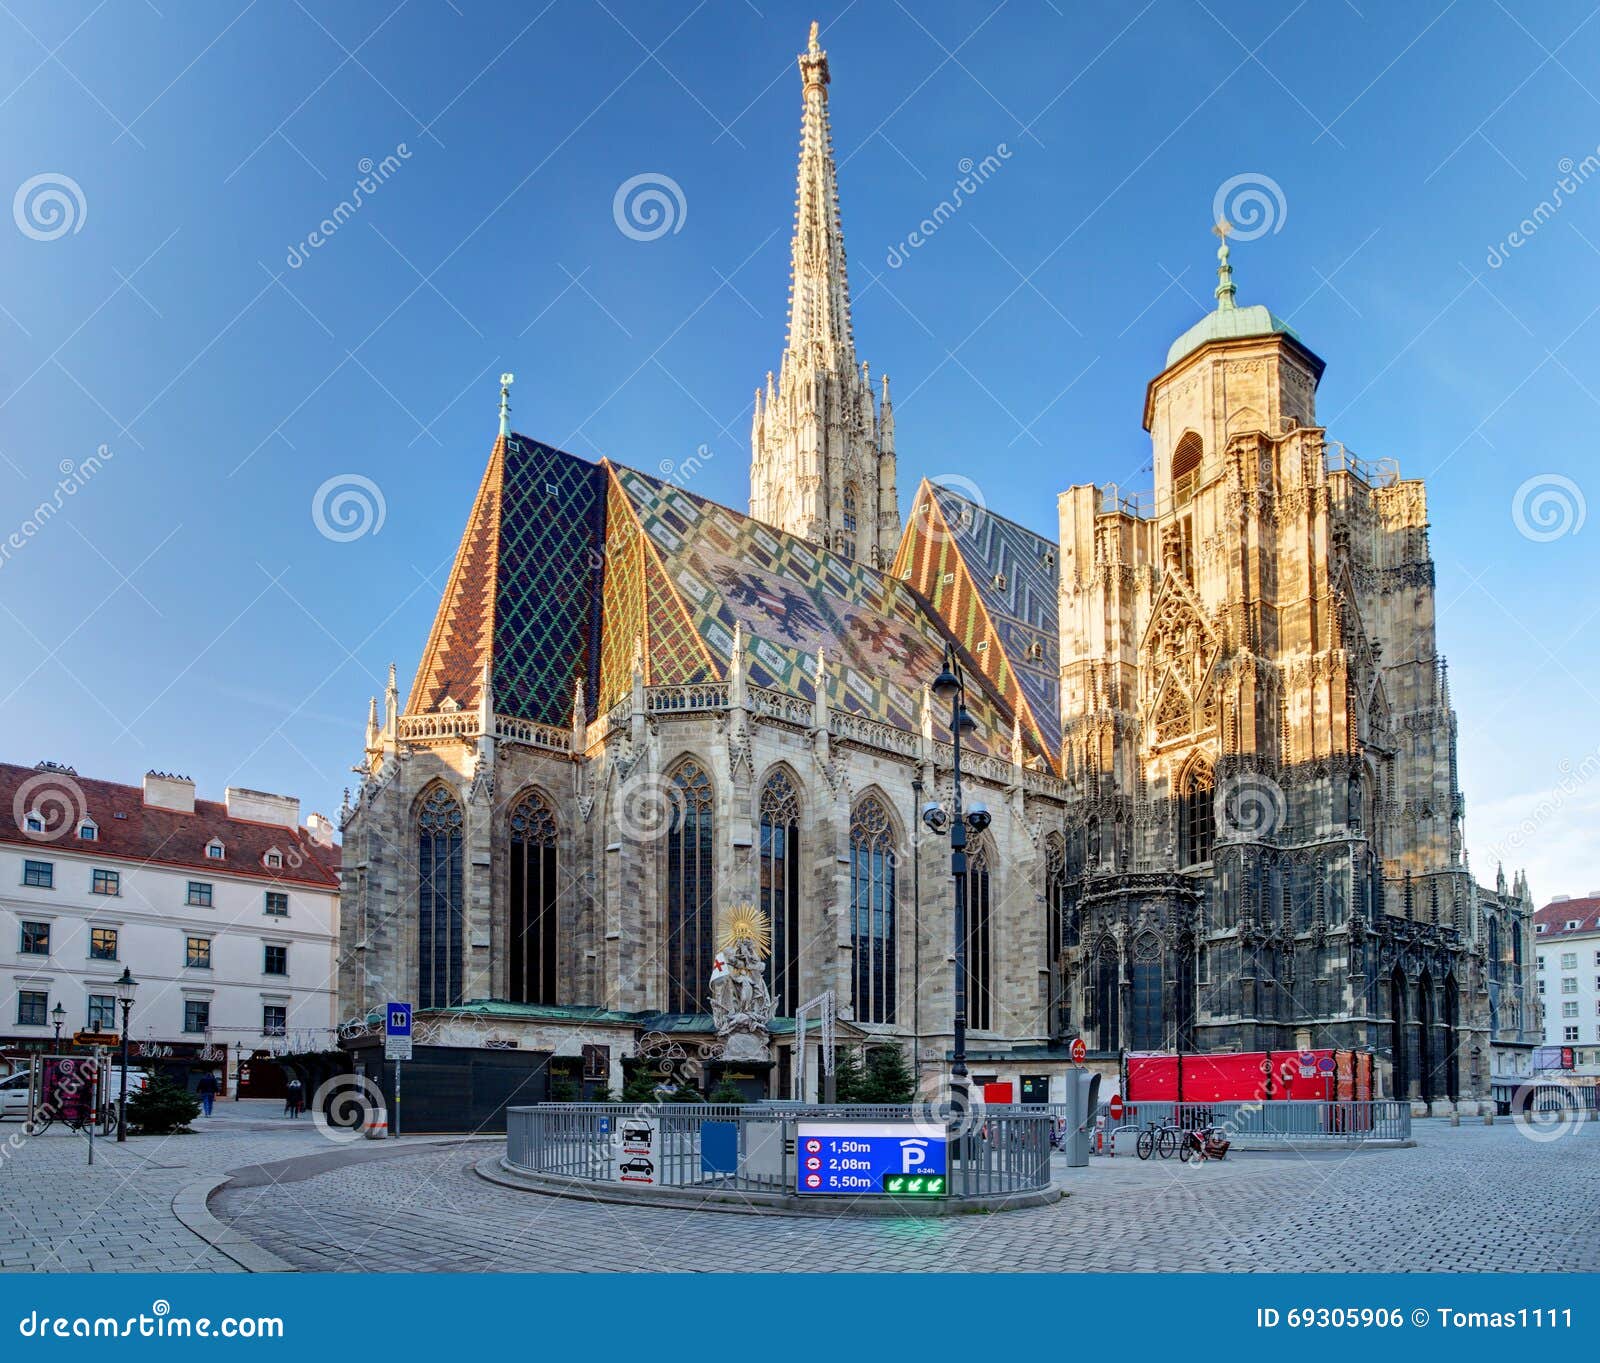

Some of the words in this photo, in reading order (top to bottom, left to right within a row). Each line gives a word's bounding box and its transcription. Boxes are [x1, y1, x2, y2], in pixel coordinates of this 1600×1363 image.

[829, 1141, 871, 1154] 1,50m
[829, 1158, 871, 1171] 2,08m
[902, 1147, 926, 1174] P
[829, 1175, 871, 1188] 5,50m
